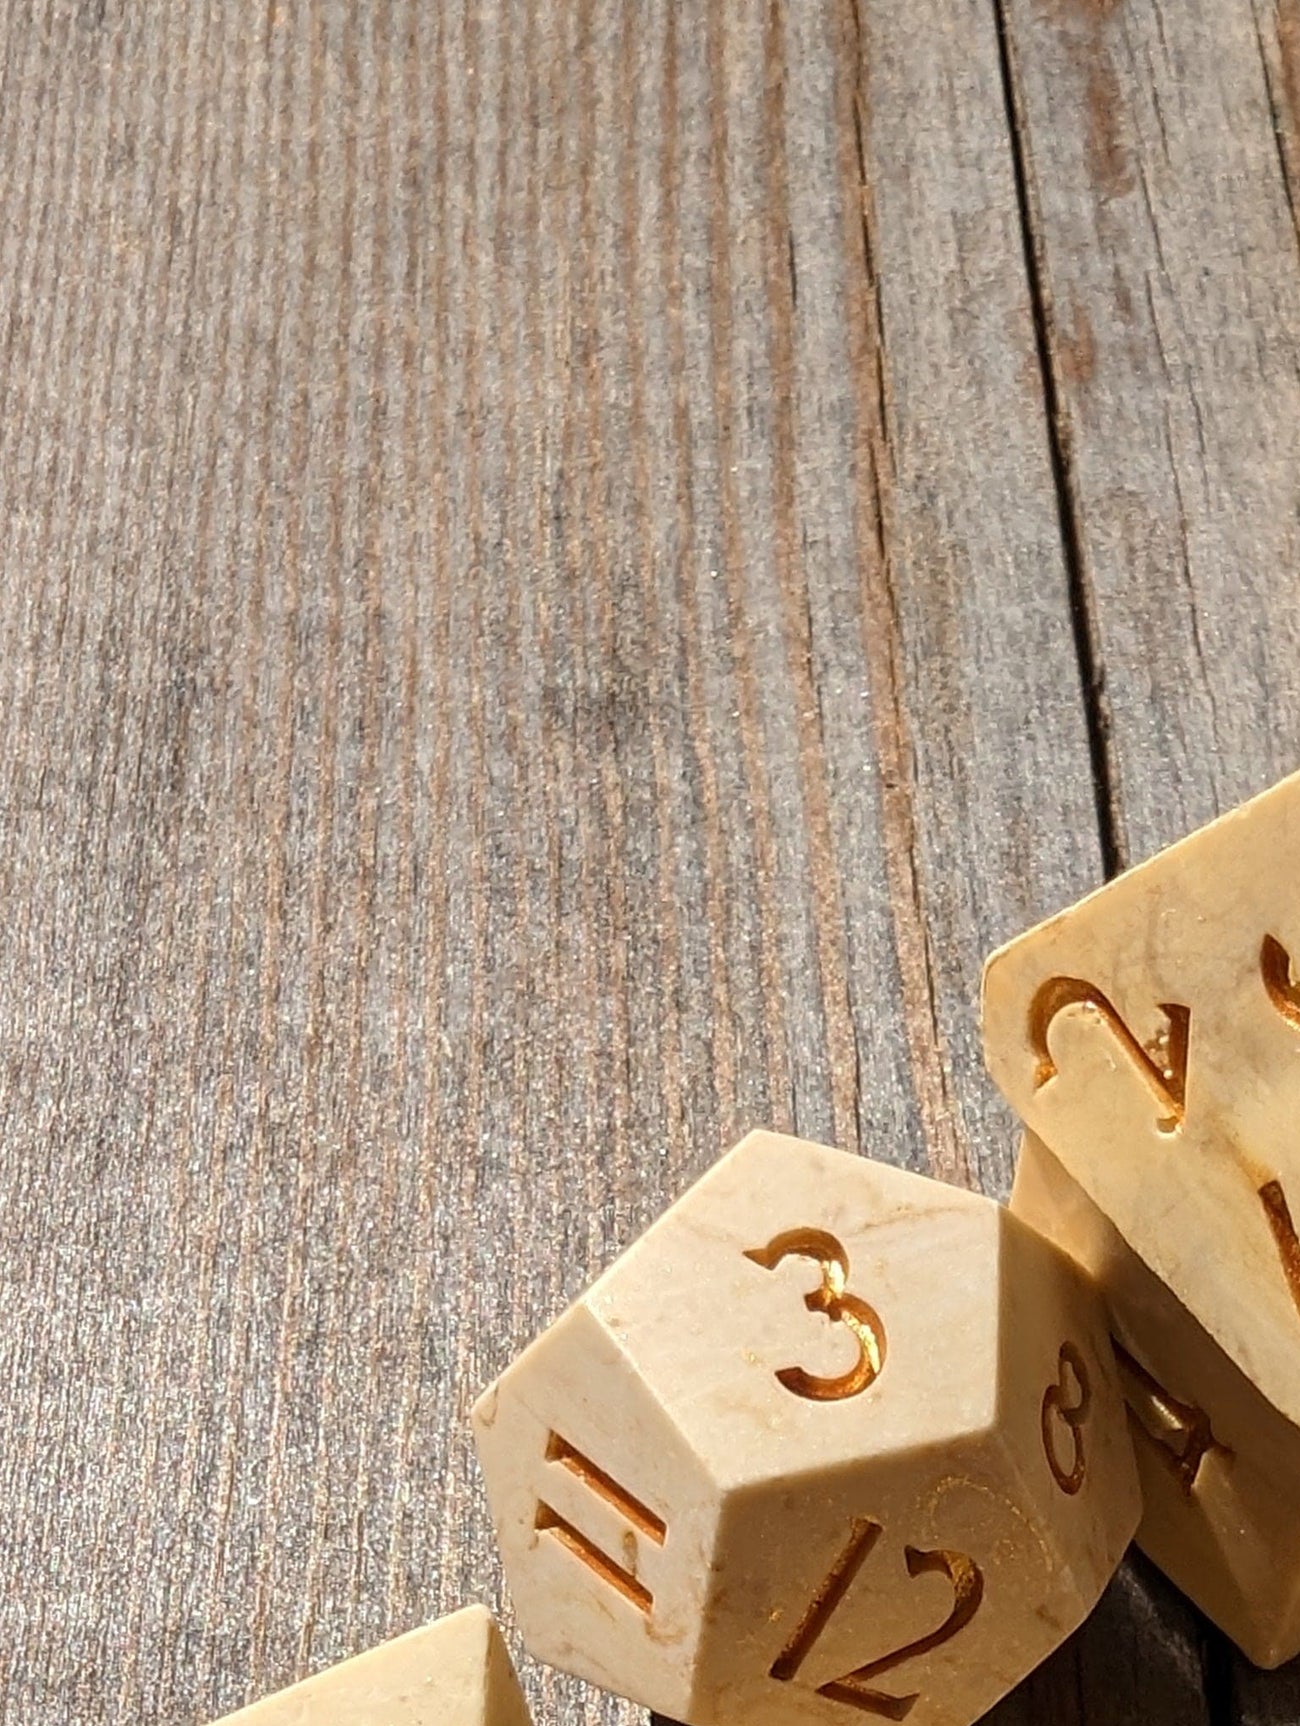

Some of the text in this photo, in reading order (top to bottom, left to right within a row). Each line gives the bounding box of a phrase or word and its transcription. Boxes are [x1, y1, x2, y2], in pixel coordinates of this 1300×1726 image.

[1030, 975, 1192, 1137] 2
[742, 1226, 888, 1402] 3
[1040, 1340, 1092, 1496] 8
[768, 1514, 985, 1722] 12
